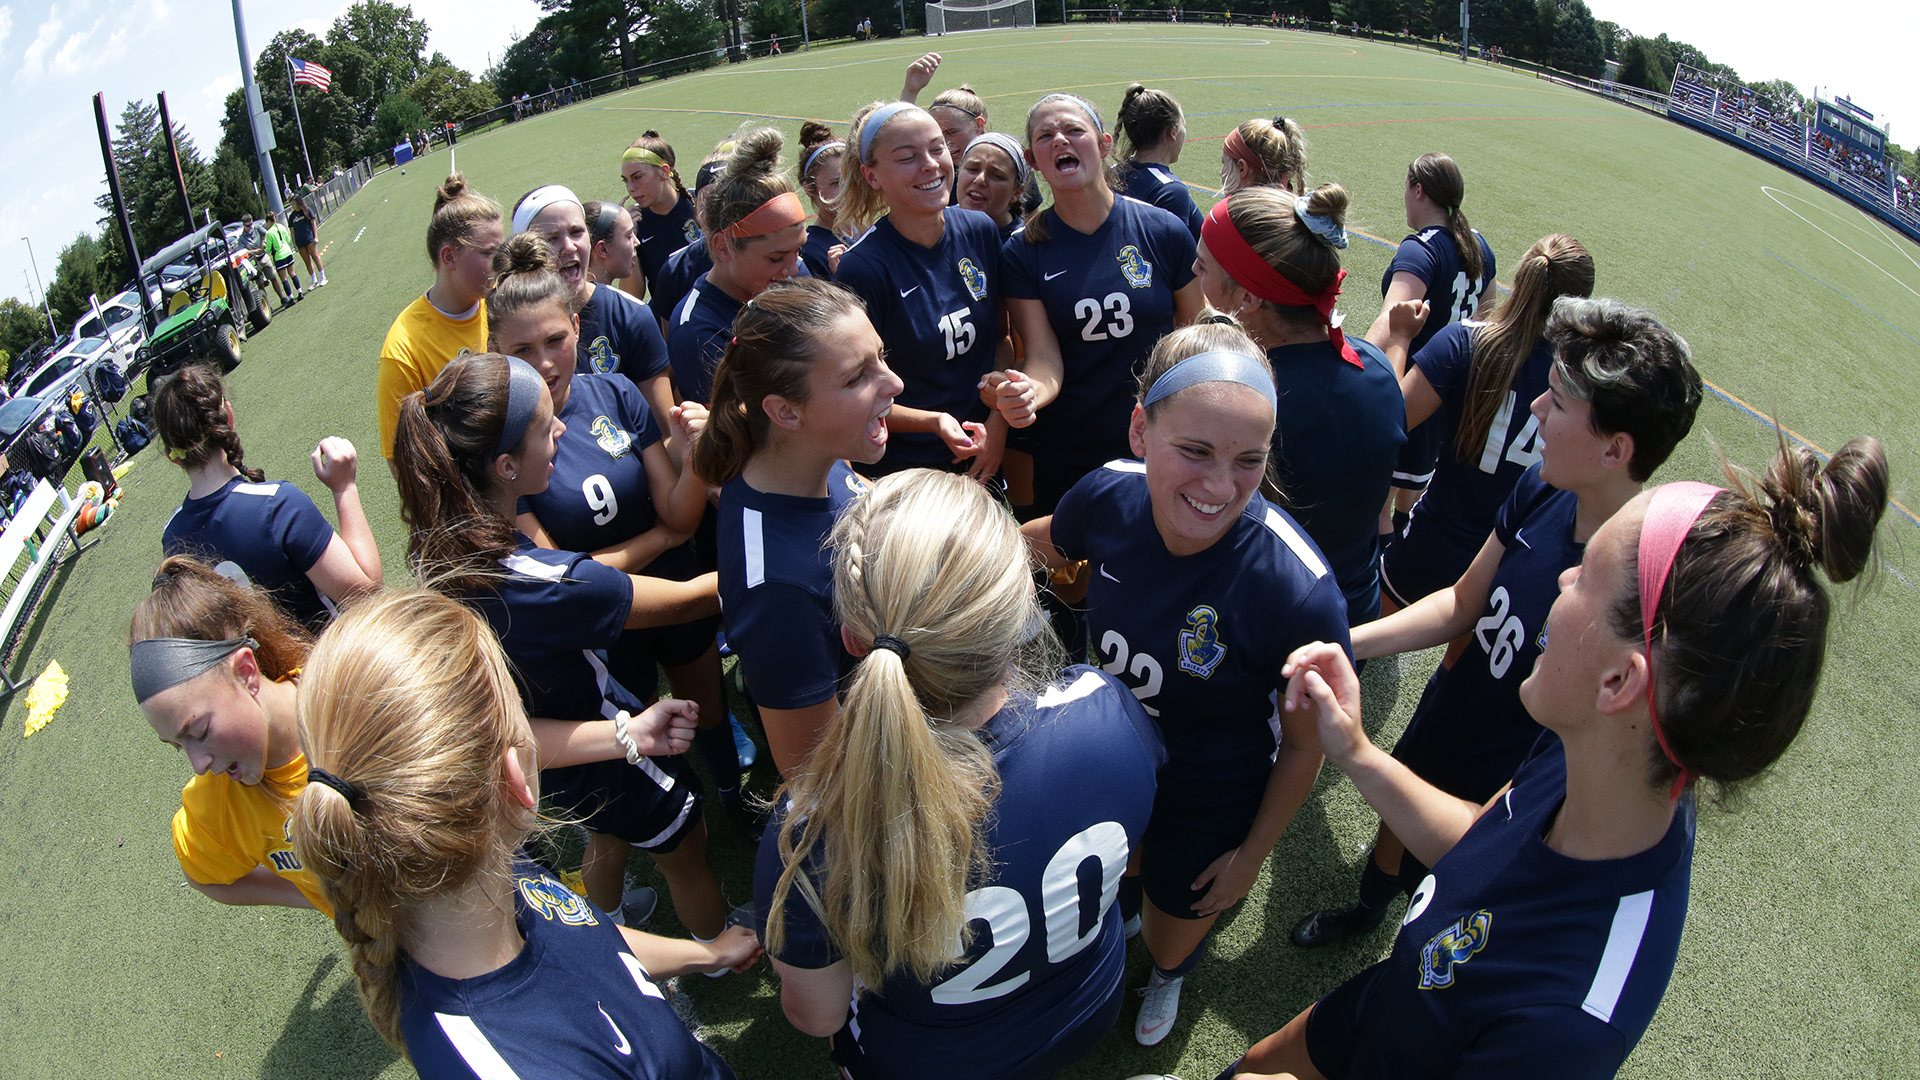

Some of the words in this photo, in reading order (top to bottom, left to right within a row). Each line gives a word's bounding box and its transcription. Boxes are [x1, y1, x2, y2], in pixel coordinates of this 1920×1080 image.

[938, 307, 976, 361] 15
[1074, 292, 1135, 341] 23
[582, 474, 619, 526] 9
[1475, 586, 1525, 679] 26
[1101, 630, 1164, 718] 22
[930, 821, 1129, 1005] 20
